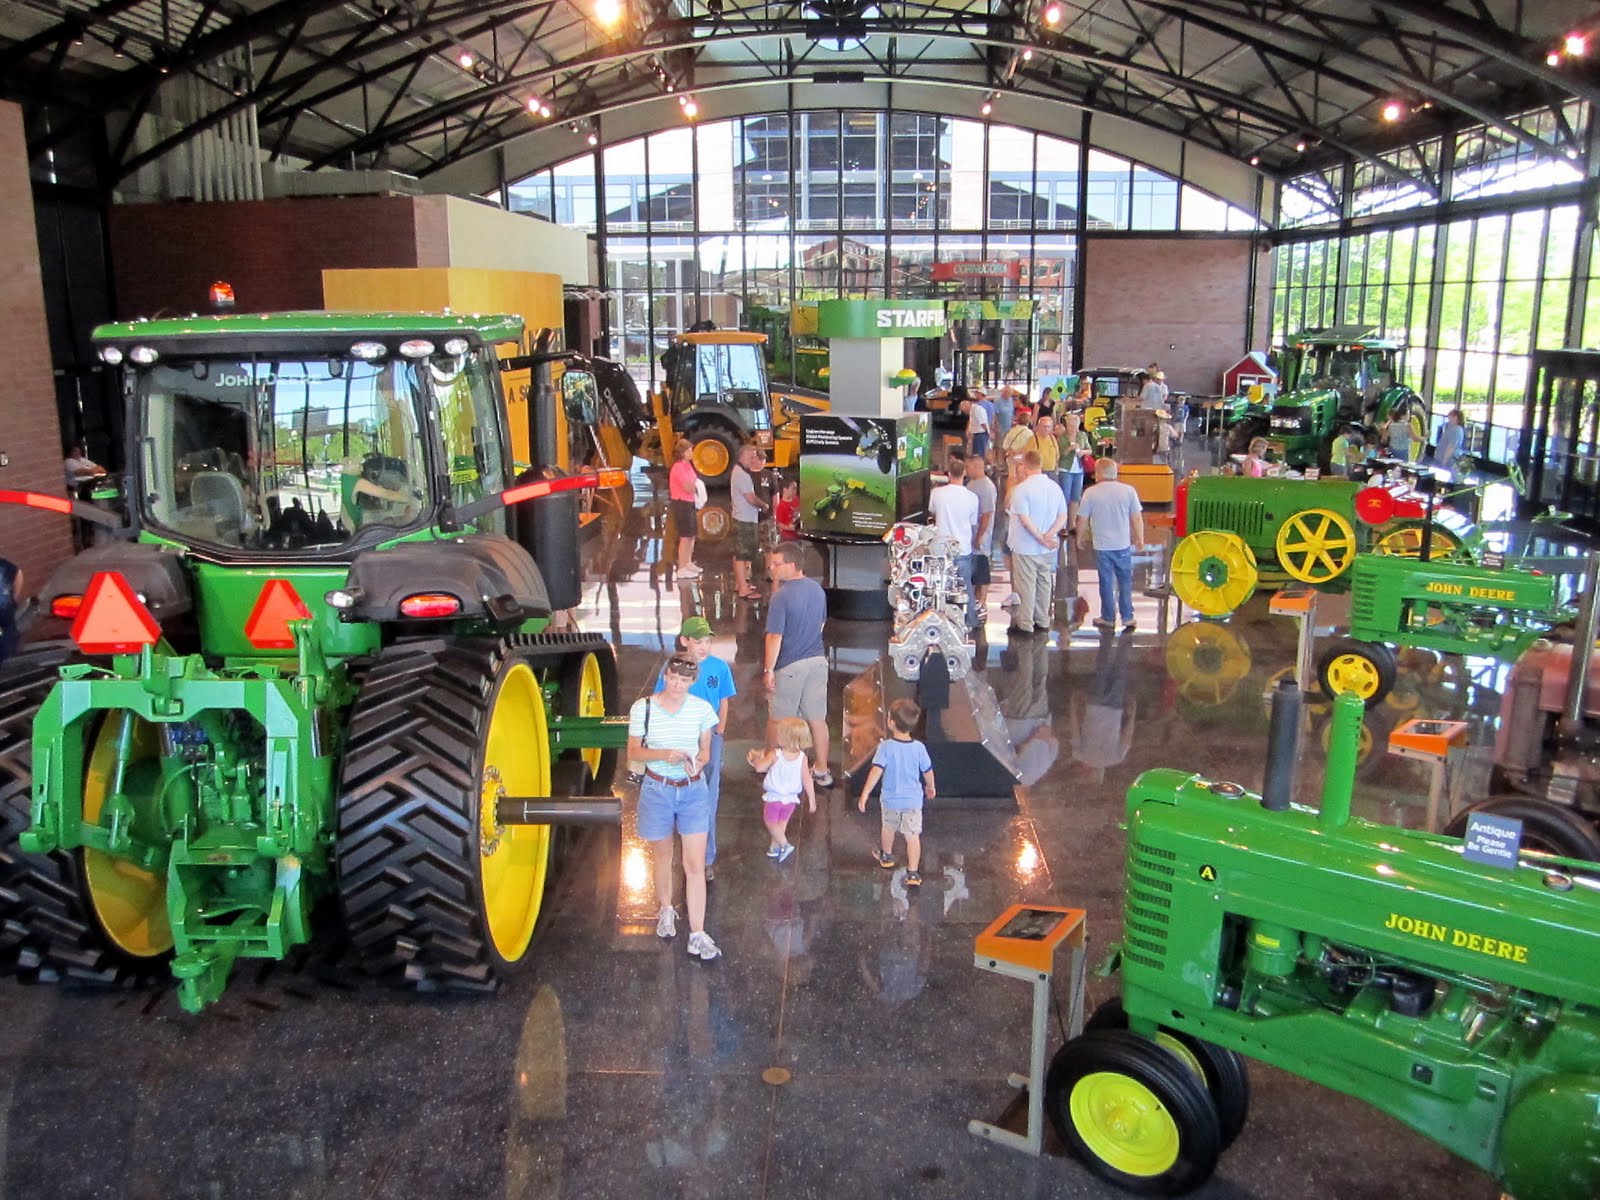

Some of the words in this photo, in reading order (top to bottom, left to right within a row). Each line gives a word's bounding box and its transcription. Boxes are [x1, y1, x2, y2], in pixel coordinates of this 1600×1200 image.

[1425, 581, 1463, 595] JOHN
[1469, 586, 1515, 601] DEERE
[1470, 821, 1517, 840] Antique
[1476, 834, 1506, 848] Please
[1201, 865, 1215, 881] A
[1384, 912, 1447, 943] JOHN
[1452, 929, 1528, 964] DEERE
